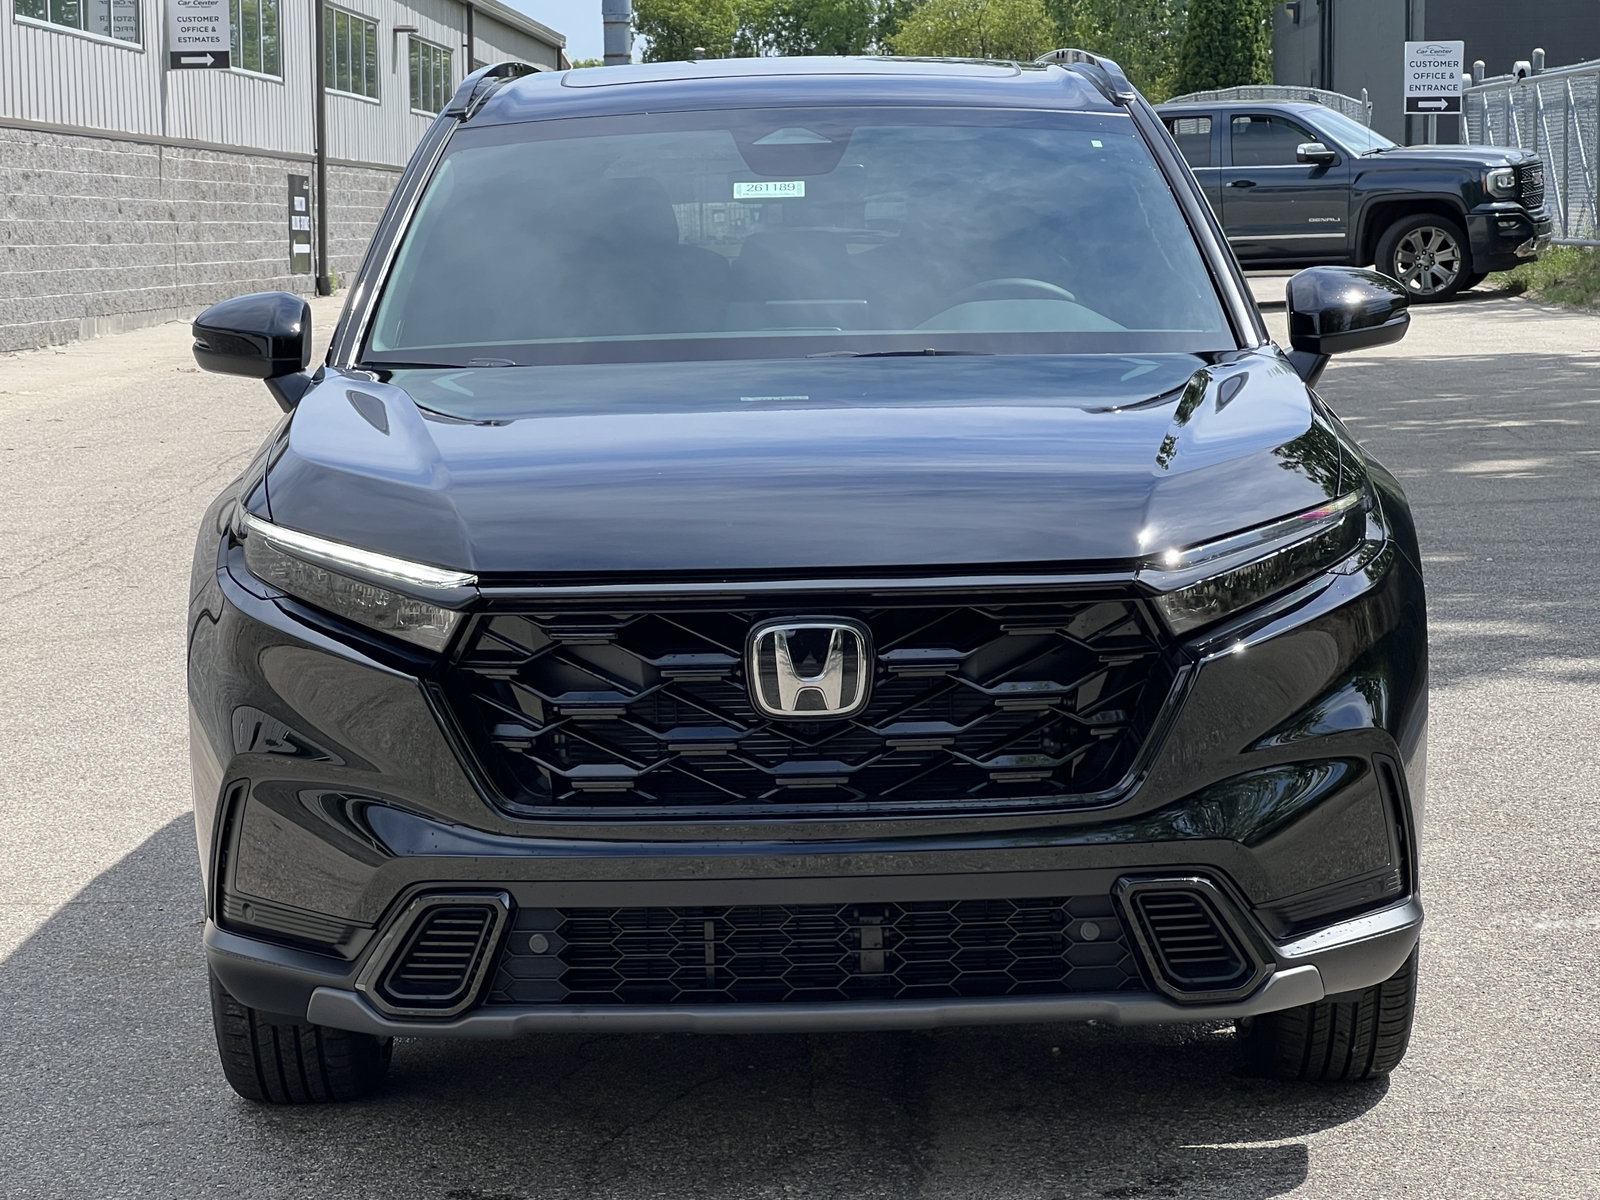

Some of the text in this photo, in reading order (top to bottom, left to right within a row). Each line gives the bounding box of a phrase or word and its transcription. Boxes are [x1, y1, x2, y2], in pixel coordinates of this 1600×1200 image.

[1409, 60, 1459, 68] CUSTOMER
[1413, 72, 1455, 80] OFFICE &
[1409, 84, 1459, 92] ENTRANCE
[746, 183, 796, 192] 261189
